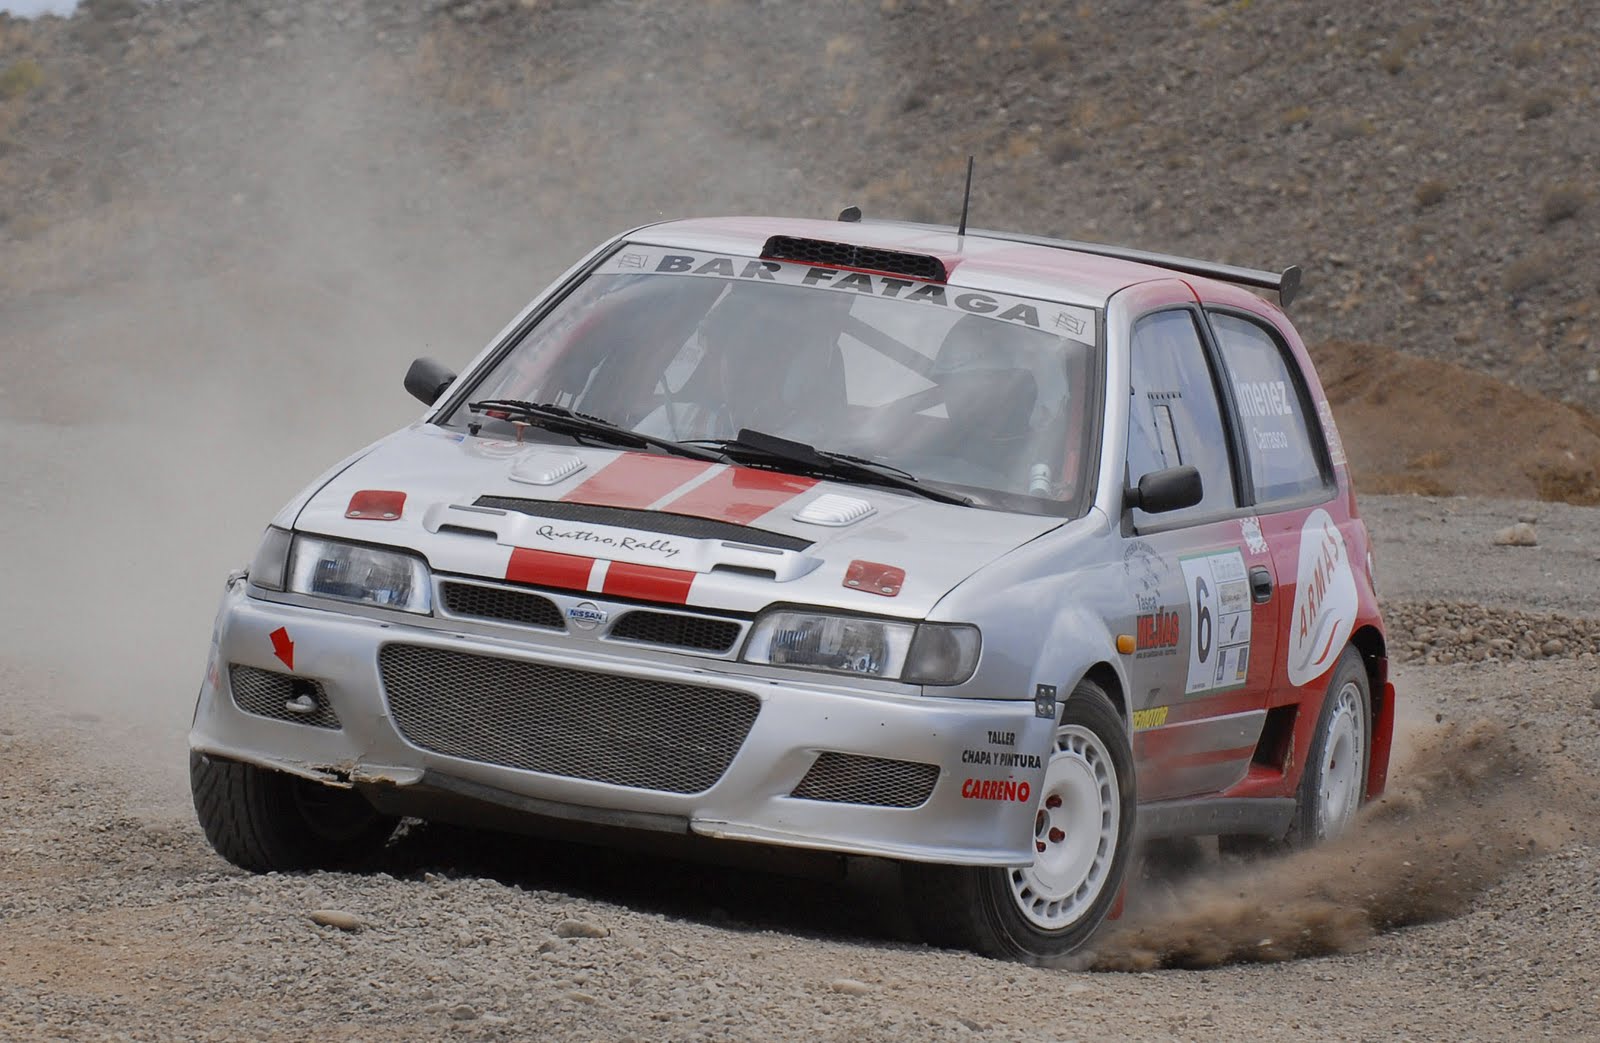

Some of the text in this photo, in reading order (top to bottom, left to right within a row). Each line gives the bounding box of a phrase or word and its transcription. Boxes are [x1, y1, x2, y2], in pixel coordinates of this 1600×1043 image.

[654, 255, 1041, 328] BAR FATAGA
[1299, 520, 1339, 649] ARMAS
[569, 609, 603, 621] NISSAN
[1195, 576, 1212, 664] 6
[987, 730, 1016, 746] TALLER
[961, 750, 1042, 769] CHAPA Y PINTURA
[961, 775, 1031, 803] CARREÑO
